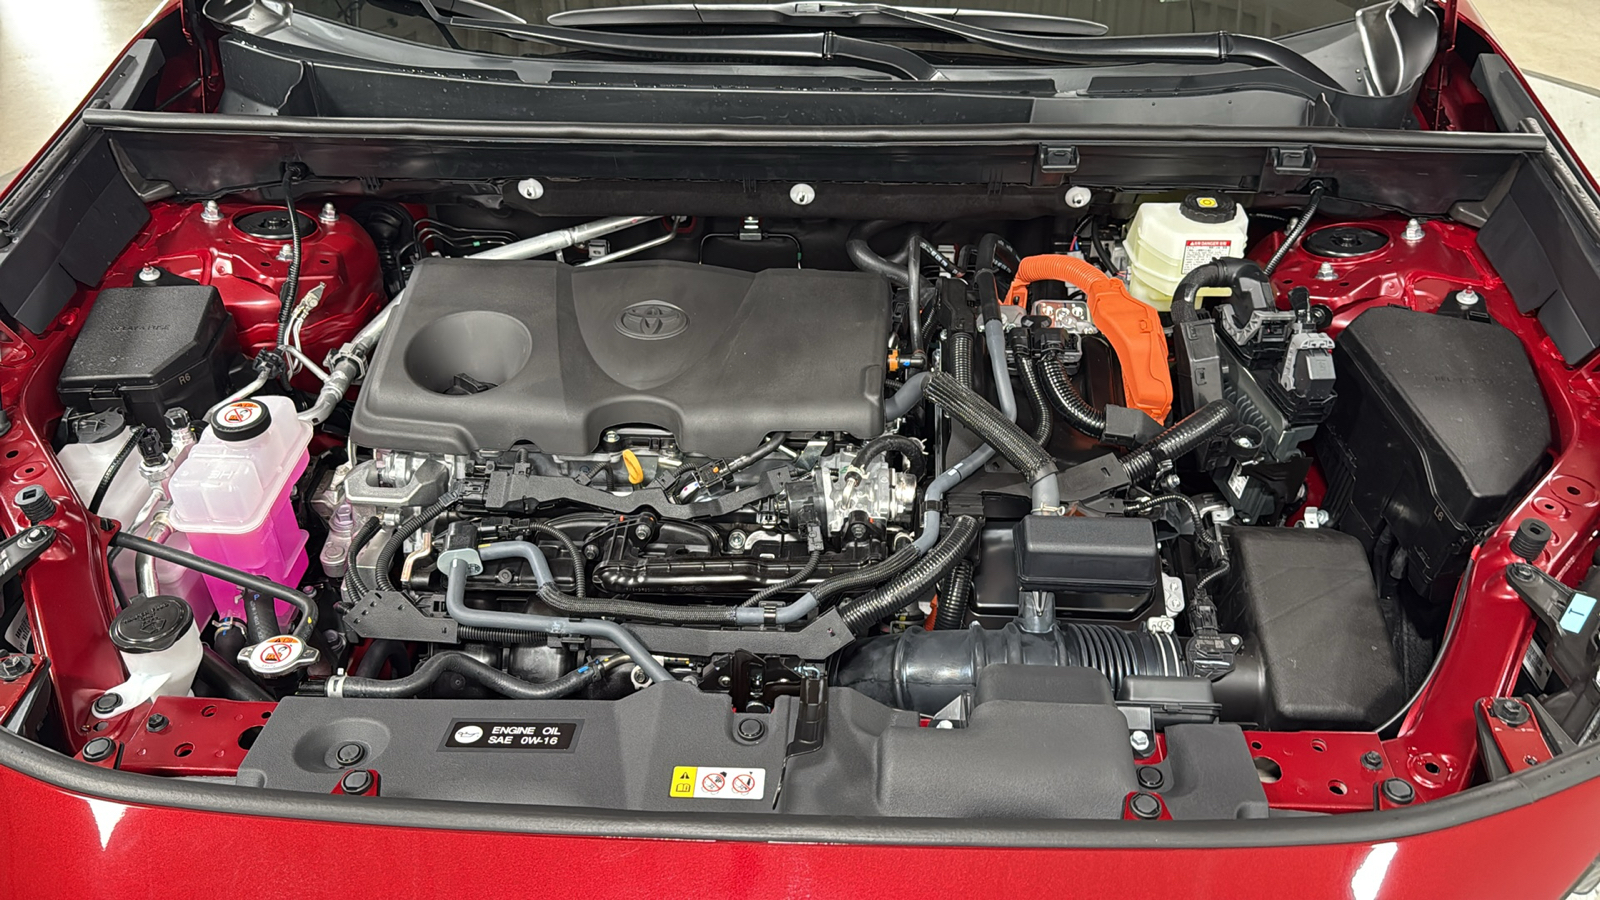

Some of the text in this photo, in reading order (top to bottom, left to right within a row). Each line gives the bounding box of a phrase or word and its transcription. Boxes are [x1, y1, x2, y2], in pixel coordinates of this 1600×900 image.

[178, 372, 191, 386] R6
[1433, 504, 1444, 522] L6
[1568, 607, 1585, 617] T
[491, 726, 561, 735] ENGINE OIL
[487, 736, 558, 745] SAE 0W-16
